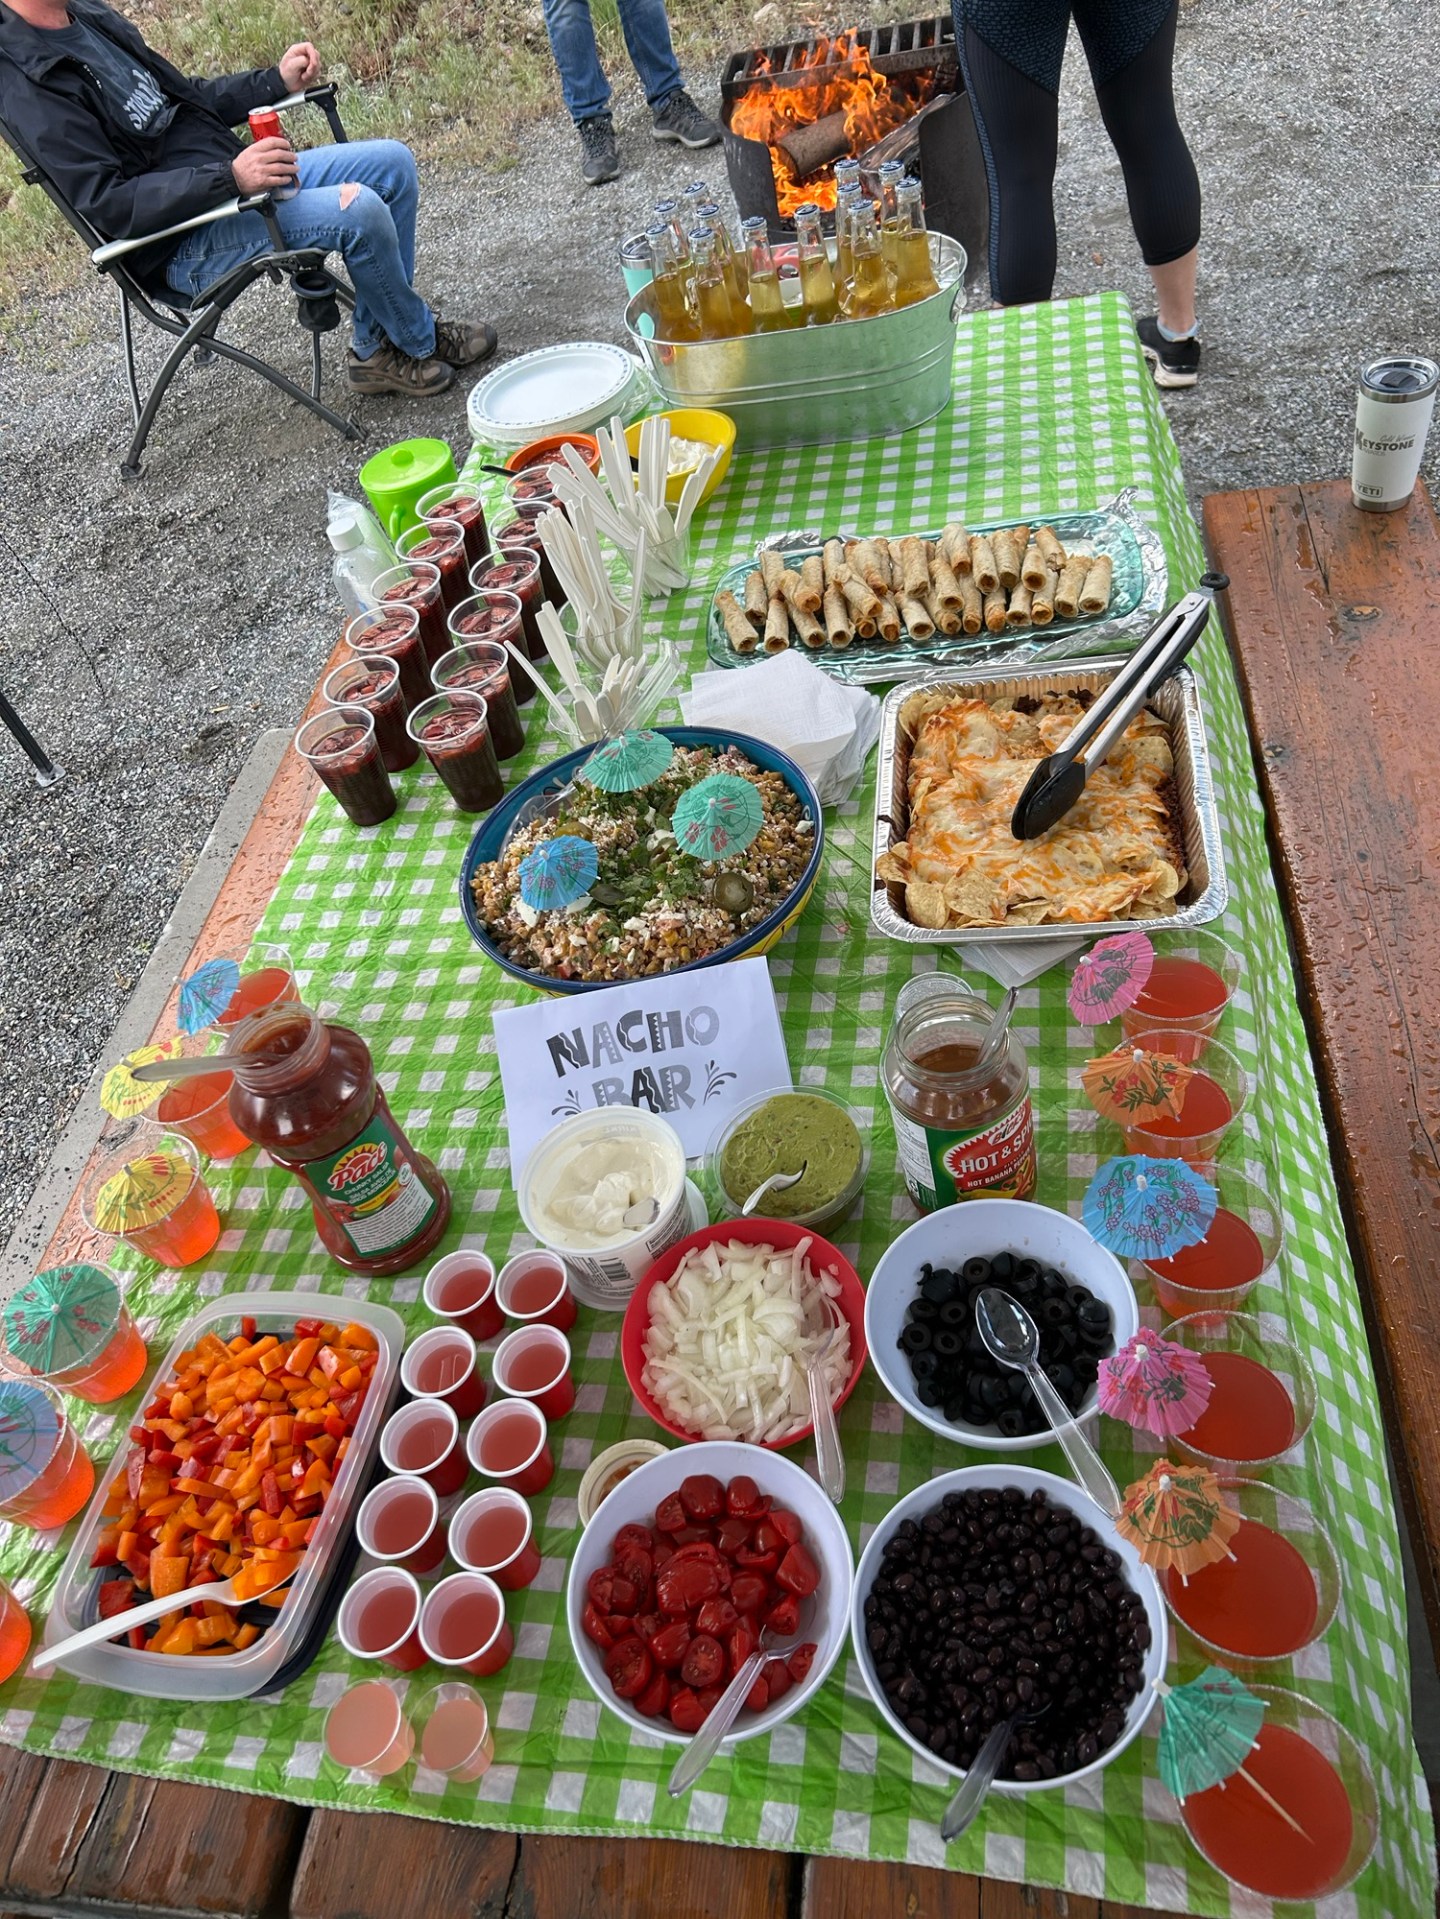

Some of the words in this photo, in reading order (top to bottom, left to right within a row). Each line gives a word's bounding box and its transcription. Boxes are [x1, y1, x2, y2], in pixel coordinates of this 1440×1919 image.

[1355, 428, 1415, 451] KEYSTONE
[1357, 483, 1380, 496] YETI
[546, 1005, 720, 1078] NACHO
[592, 1064, 696, 1114] BAR
[959, 1151, 999, 1173] HOT
[1001, 1145, 1012, 1159] &
[967, 1179, 983, 1188] HOT
[984, 1166, 1013, 1184] BANANA
